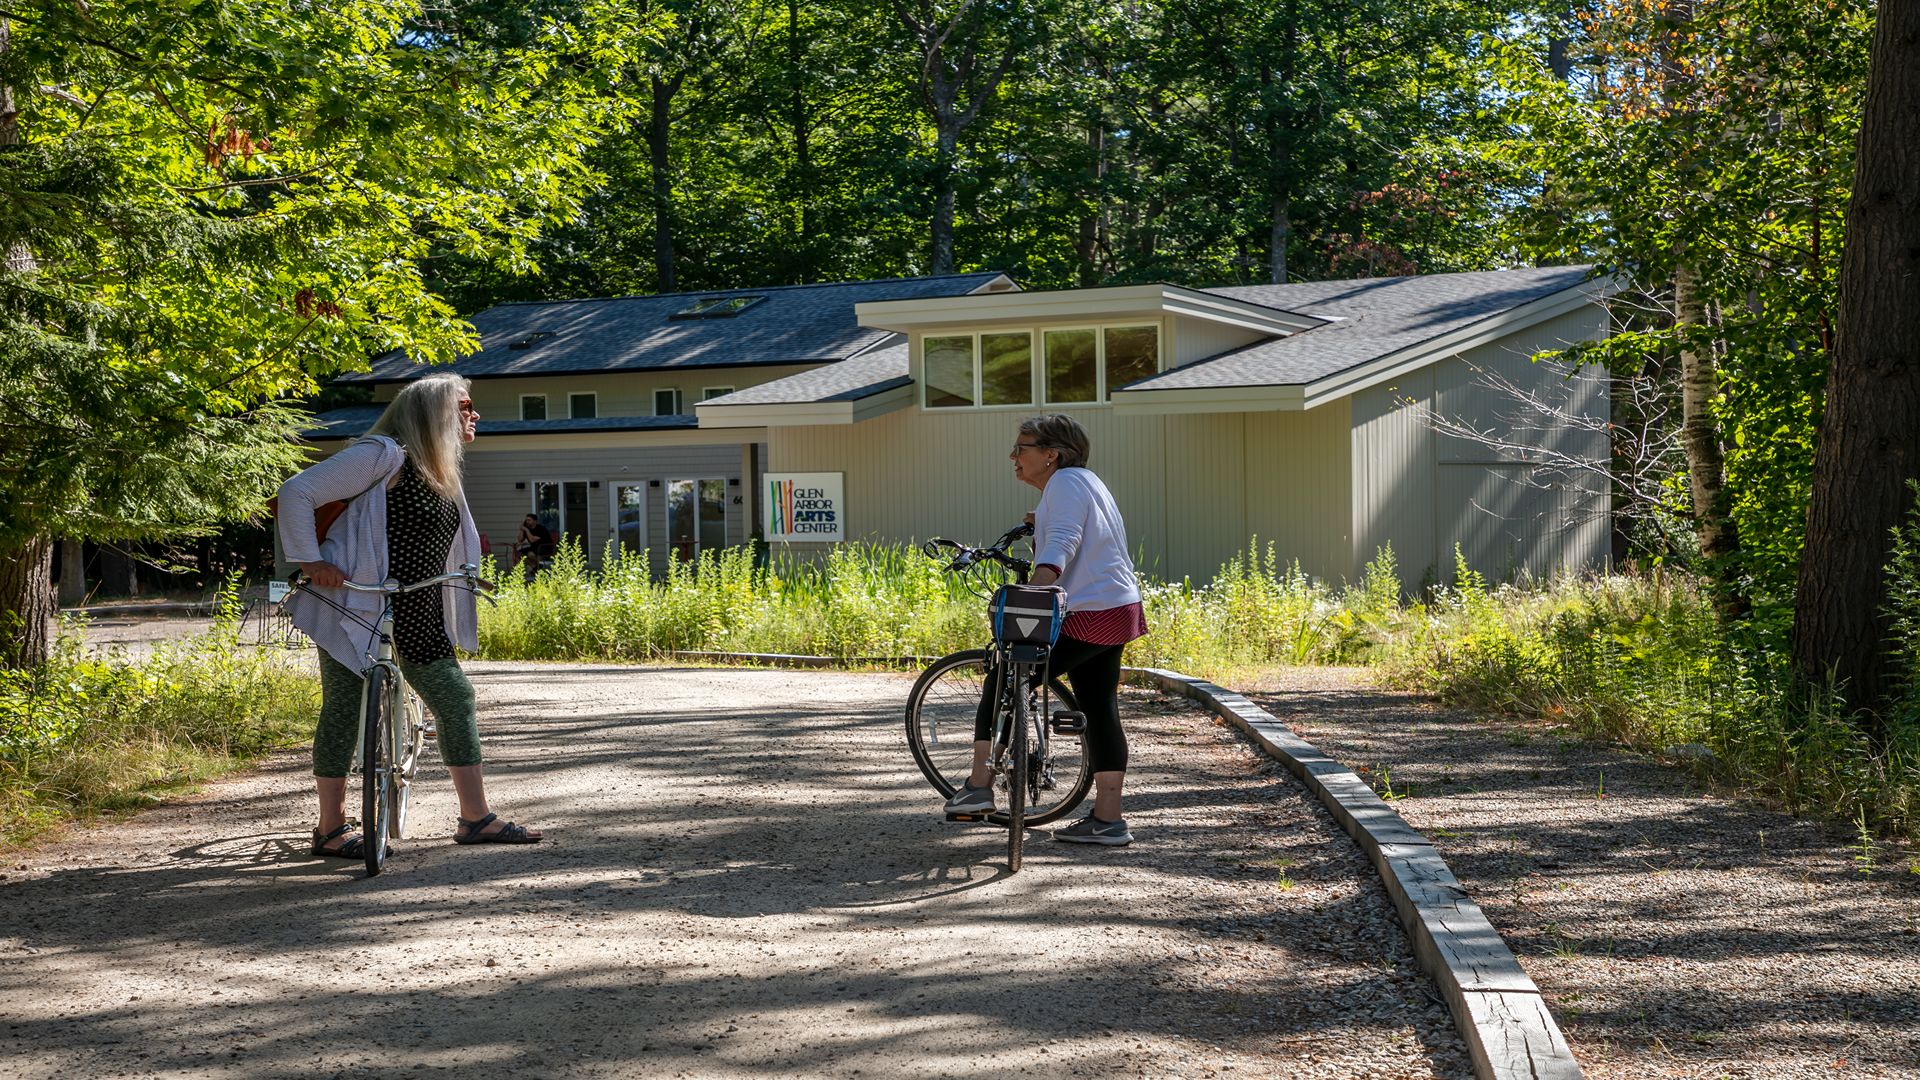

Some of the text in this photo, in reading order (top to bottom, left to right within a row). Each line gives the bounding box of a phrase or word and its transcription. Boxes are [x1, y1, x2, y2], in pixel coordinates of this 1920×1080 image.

[794, 488, 824, 499] GLEN
[794, 500, 833, 510] ARBOR
[794, 511, 836, 522] ARTS
[794, 523, 838, 533] CENTER
